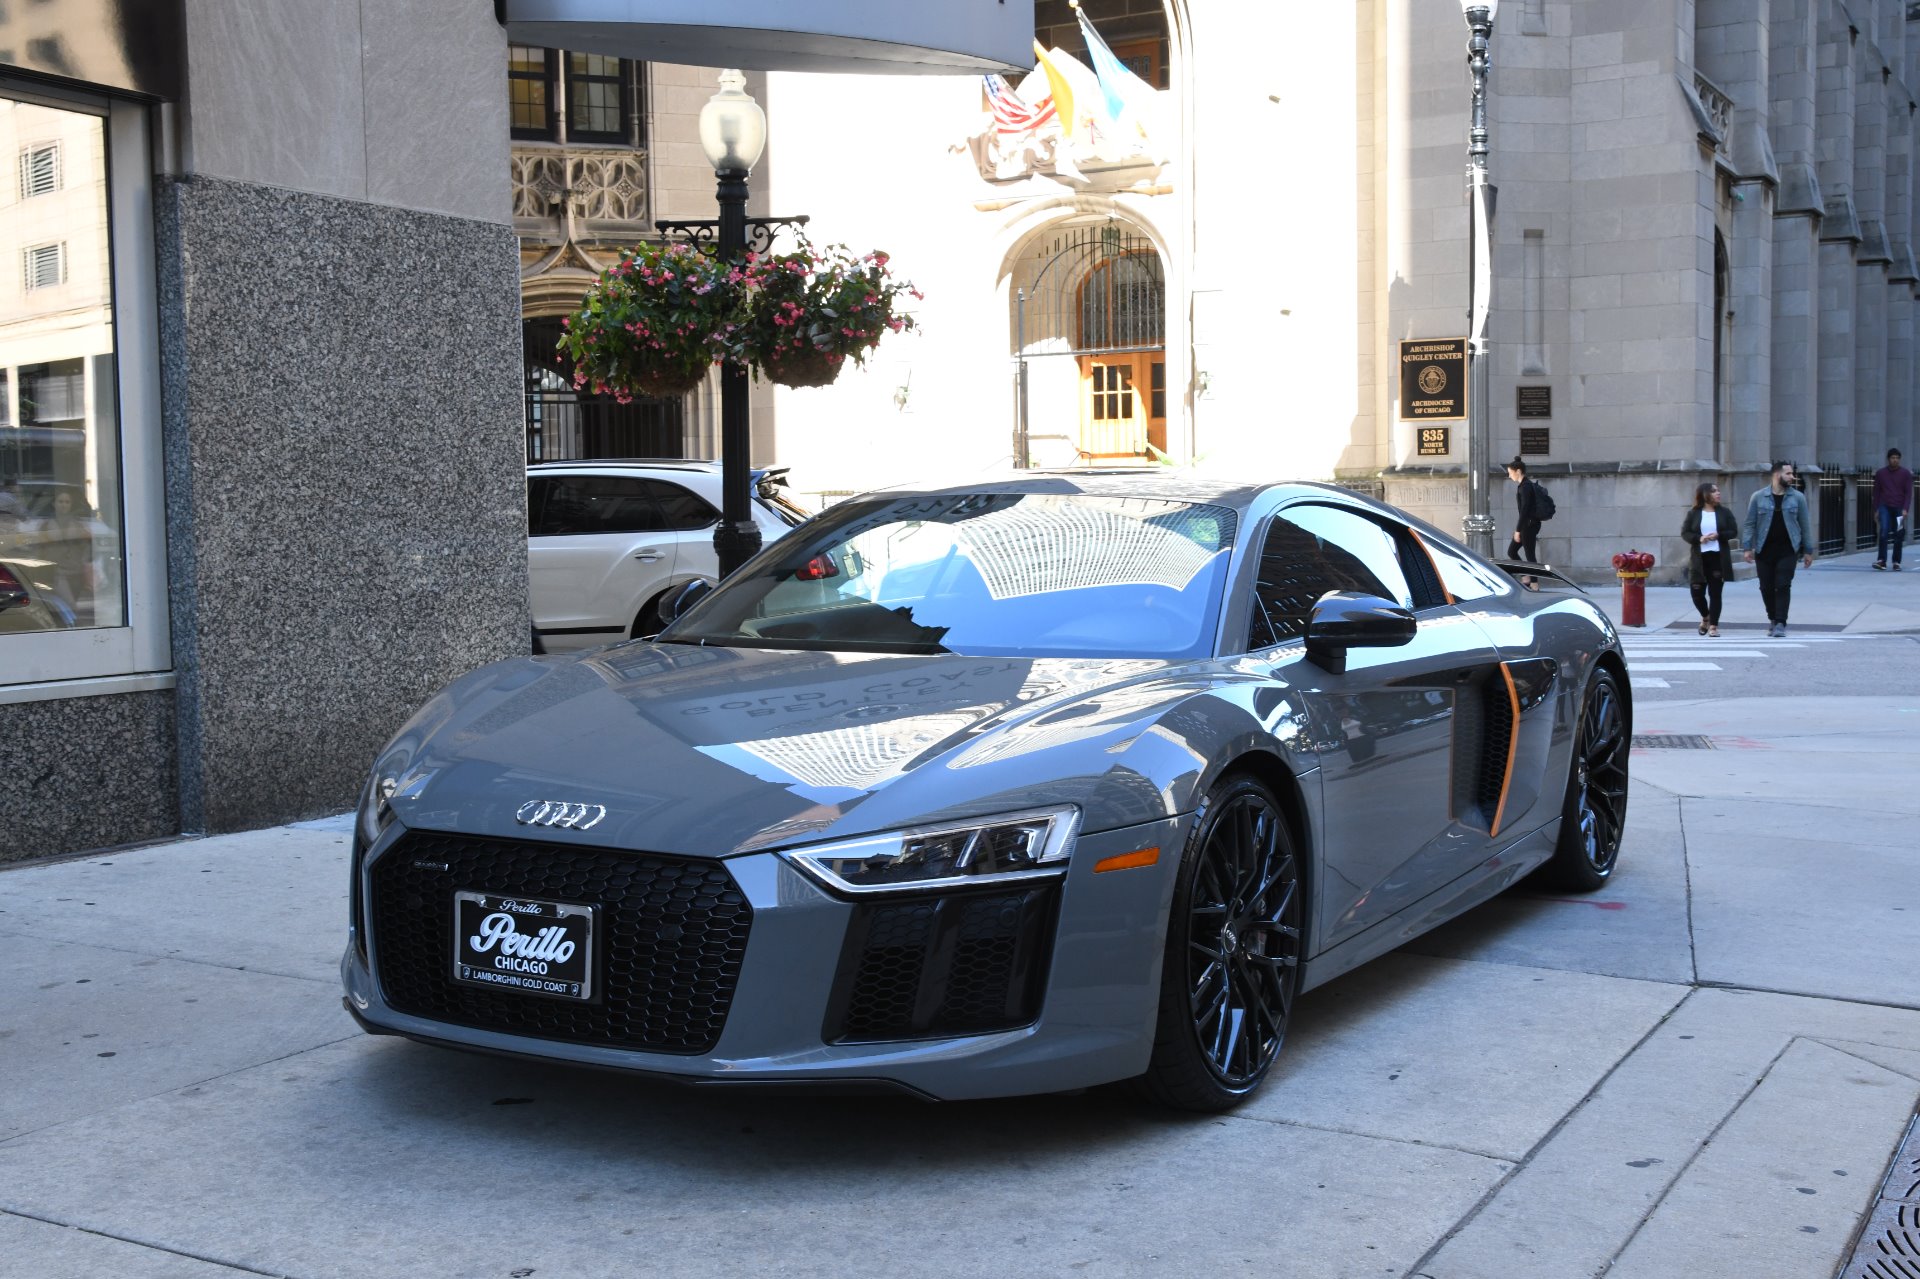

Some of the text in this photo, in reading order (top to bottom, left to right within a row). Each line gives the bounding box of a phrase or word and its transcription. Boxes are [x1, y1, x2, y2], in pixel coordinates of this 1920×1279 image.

[1410, 344, 1456, 353] ARCHBISHOP
[1402, 352, 1463, 363] QUIGLEY CENTER
[1411, 399, 1454, 407] ARCHDIOCESE
[1423, 406, 1451, 414] CHICAGO
[1422, 429, 1444, 442] 835
[499, 899, 543, 914] Perillo
[470, 912, 576, 964] Perillo
[494, 955, 548, 975] CHICAGO
[473, 970, 568, 993] LAMBORGHINI GOLD COAST
